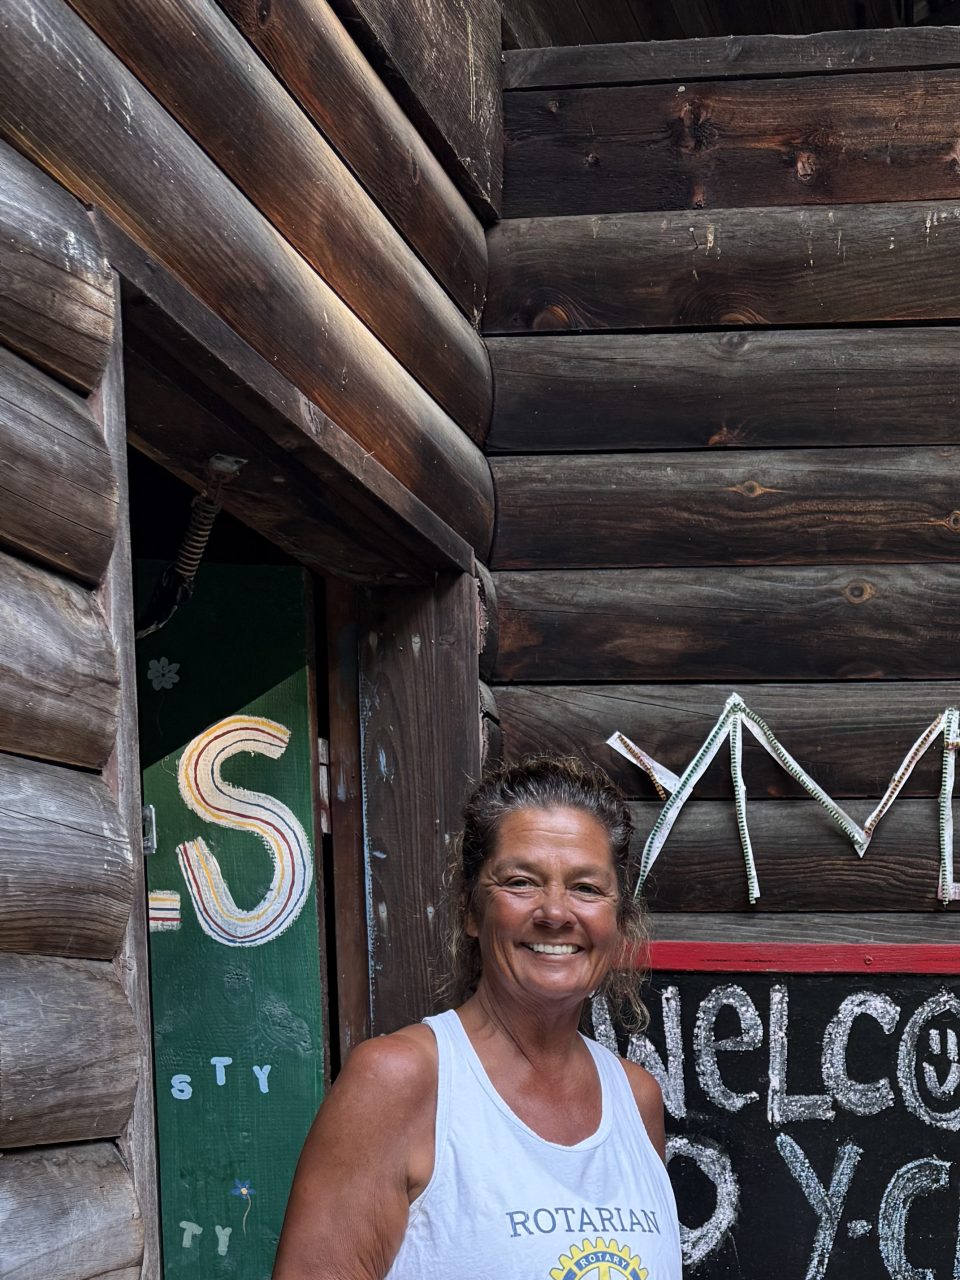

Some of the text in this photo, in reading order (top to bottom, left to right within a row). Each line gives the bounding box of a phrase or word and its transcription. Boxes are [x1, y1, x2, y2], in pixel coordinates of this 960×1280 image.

[149, 715, 313, 947] S
[506, 1207, 661, 1238] ROTARIAN
[665, 1133, 741, 1268] O
[580, 1253, 628, 1269] ROTARY
